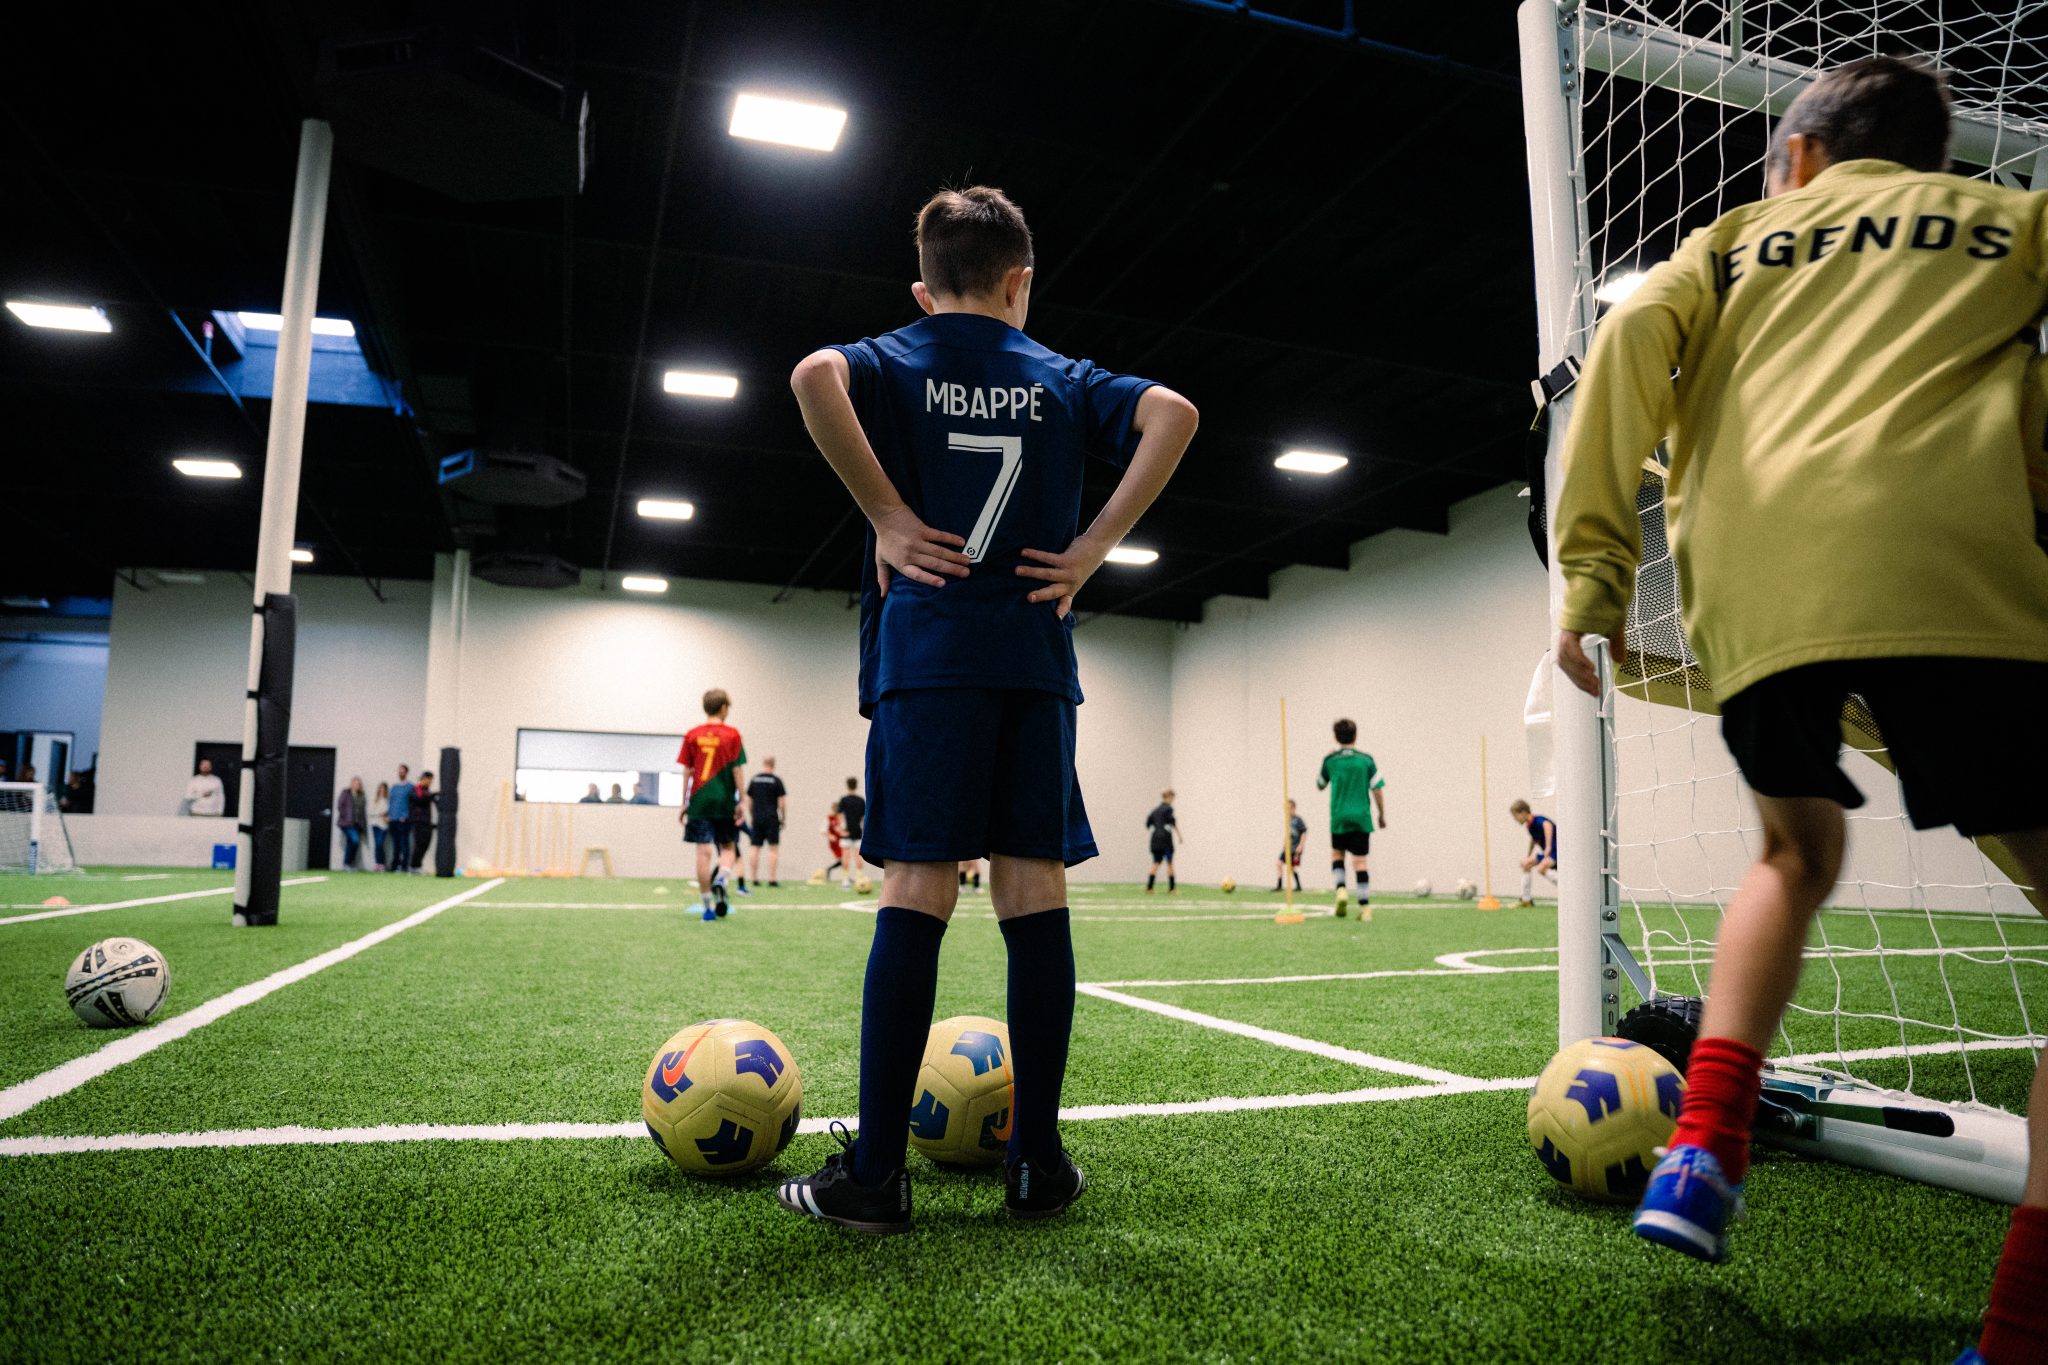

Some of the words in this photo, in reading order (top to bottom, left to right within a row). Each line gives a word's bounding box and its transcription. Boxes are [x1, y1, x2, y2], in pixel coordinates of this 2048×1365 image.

[926, 378, 1043, 421] MBAPPÉ
[948, 432, 1022, 563] 7
[700, 746, 717, 781] 7
[899, 1181, 908, 1212] PREDATOR
[1019, 1169, 1029, 1199] PREDATOR
